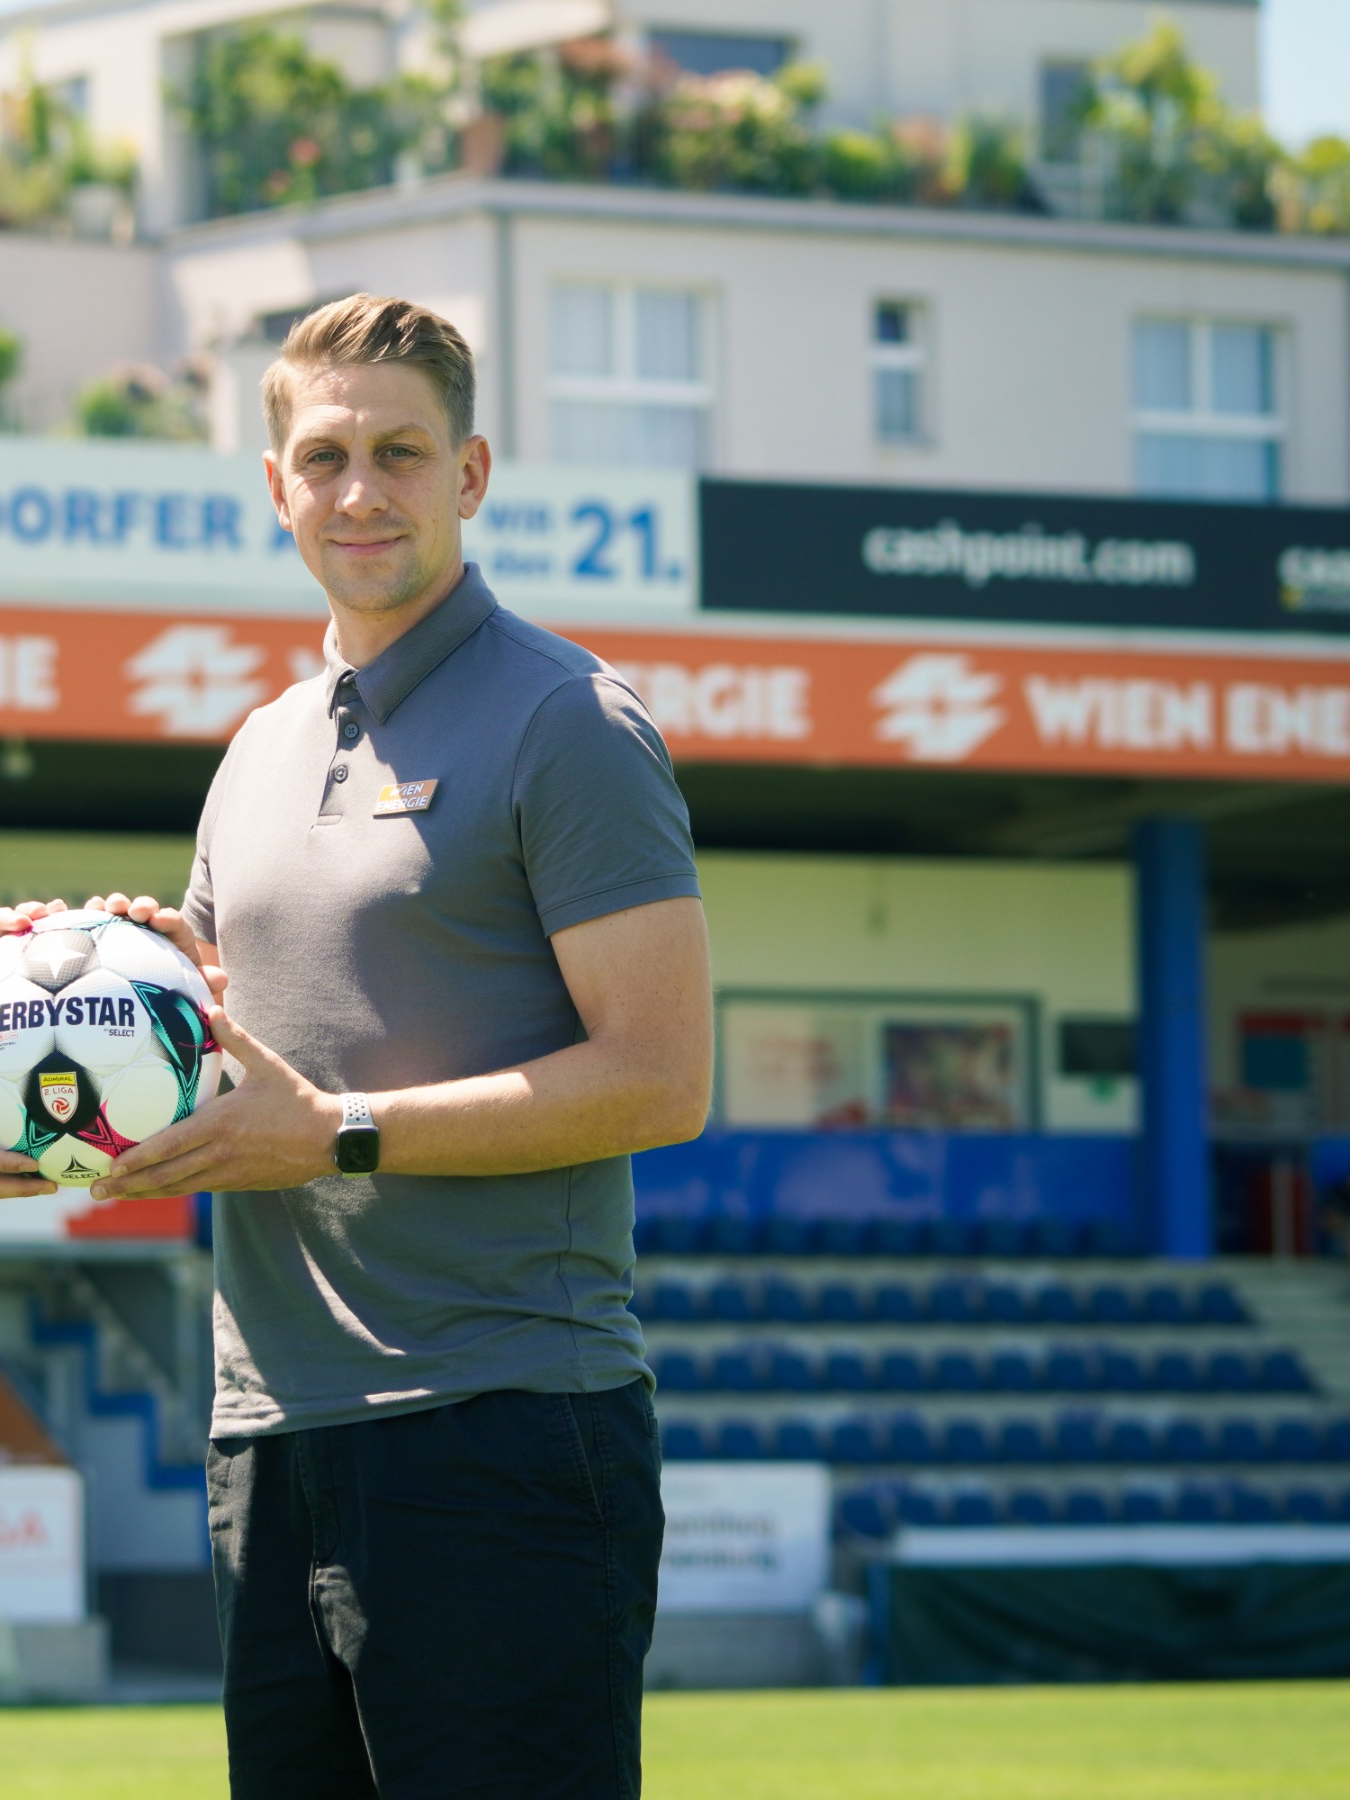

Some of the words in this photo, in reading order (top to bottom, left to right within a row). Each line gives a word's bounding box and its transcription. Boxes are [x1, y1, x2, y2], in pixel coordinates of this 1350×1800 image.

[572, 502, 683, 579] 21.
[863, 519, 1196, 588] cashpoint.com
[615, 661, 814, 741] RGIE
[1021, 673, 1214, 750] WIEN
[375, 795, 428, 812] ENERGIE
[389, 783, 424, 798] WIEN
[109, 1029, 135, 1037] SELECT
[53, 1087, 74, 1095] LIGA
